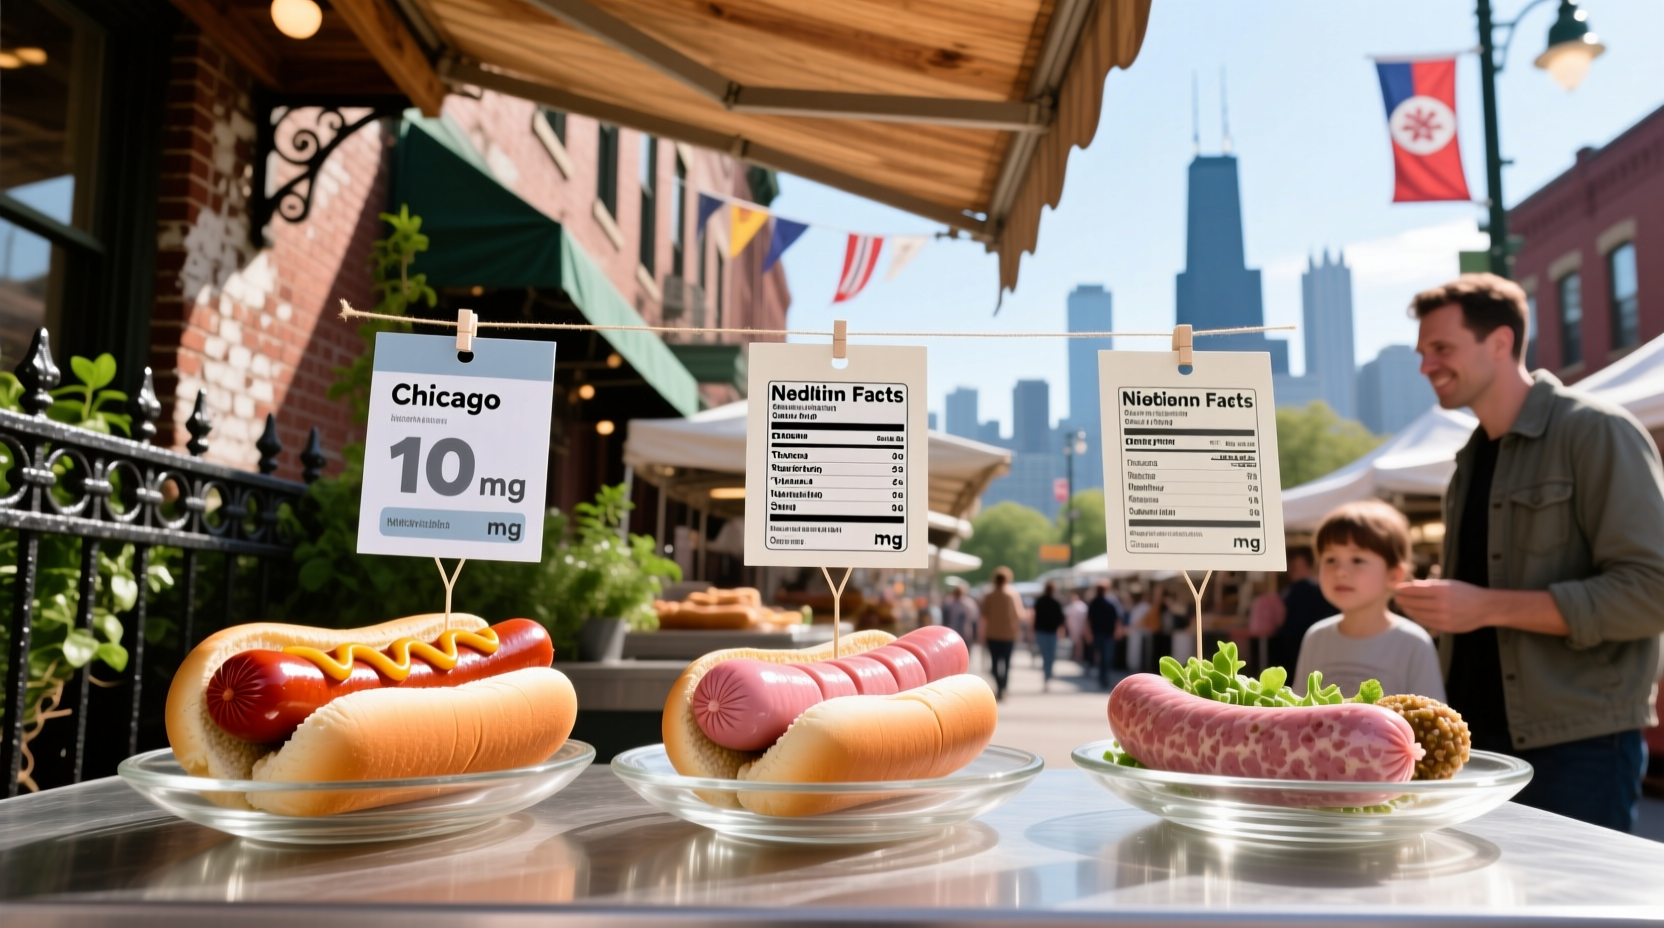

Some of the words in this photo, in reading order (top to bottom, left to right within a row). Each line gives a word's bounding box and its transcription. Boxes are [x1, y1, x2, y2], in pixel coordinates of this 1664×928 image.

[391, 383, 501, 415] Chicago
[852, 386, 904, 403] Facts
[1206, 392, 1254, 408] Facts
[390, 436, 476, 497] 10
[479, 477, 526, 503] mg
[487, 521, 521, 541] mg
[874, 533, 903, 550] mg
[1233, 537, 1261, 552] mg
